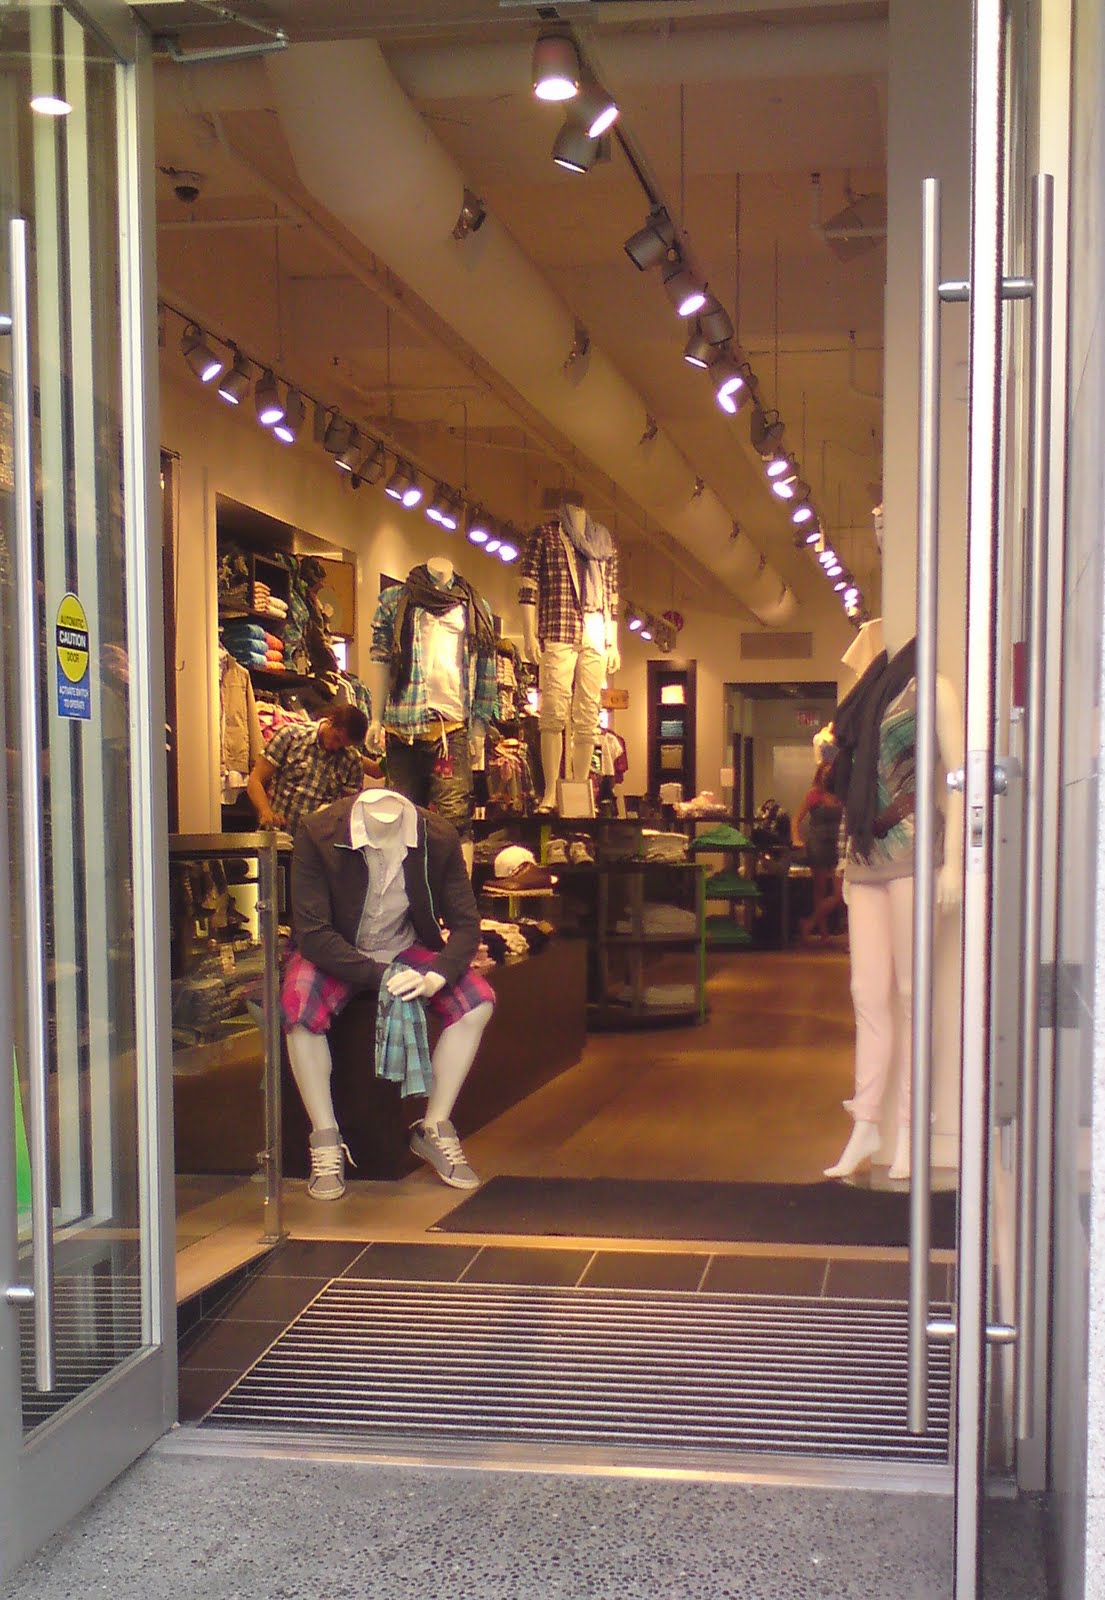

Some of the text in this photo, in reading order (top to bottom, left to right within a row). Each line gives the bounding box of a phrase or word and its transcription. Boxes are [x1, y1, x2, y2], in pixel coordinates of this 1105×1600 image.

[60, 615, 84, 629] AUTOMATIC
[60, 630, 86, 648] CAUTION
[67, 651, 80, 663] DOOR
[59, 685, 76, 696] ACTIVATE
[63, 698, 70, 708] TO
